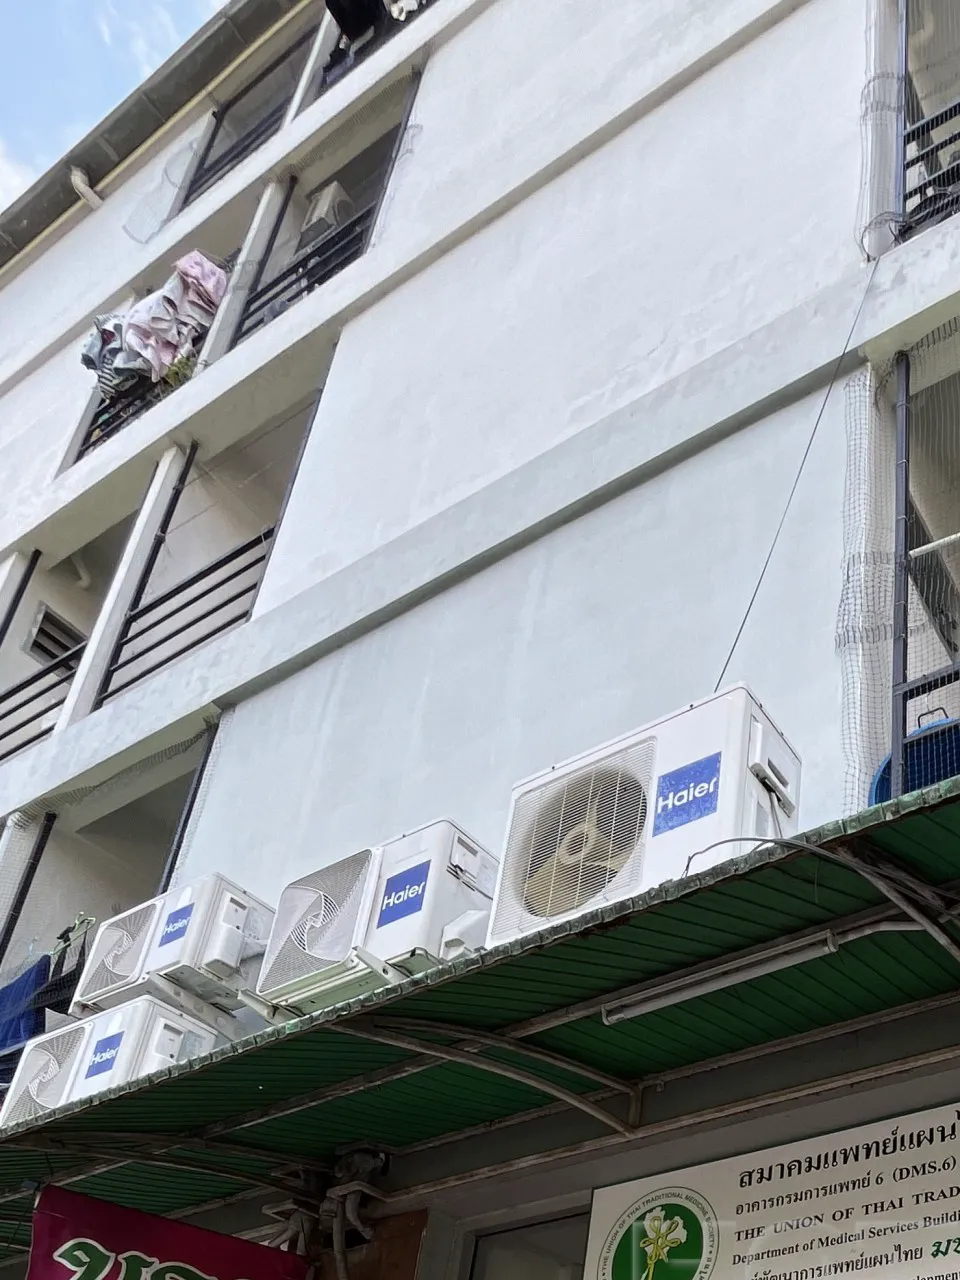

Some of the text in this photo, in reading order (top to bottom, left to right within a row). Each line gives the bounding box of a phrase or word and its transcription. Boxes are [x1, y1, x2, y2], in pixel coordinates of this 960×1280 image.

[657, 777, 717, 814] Haier
[382, 881, 425, 911] Haier
[163, 916, 191, 935] Haier
[89, 1047, 119, 1066] Haier
[735, 1169, 871, 1216] อาคารกรมการแพทย์
[875, 1172, 884, 1186] 6
[892, 1155, 957, 1183] (DMS.6)
[607, 1230, 620, 1255] UNION
[627, 1204, 642, 1219] THAI
[642, 1192, 684, 1207] TRADITIONAL
[685, 1194, 708, 1218] MEDICINE
[735, 1226, 766, 1242] THE
[773, 1213, 825, 1234] UNION
[832, 1207, 855, 1222] OF
[862, 1197, 904, 1216] THAI
[732, 1243, 800, 1266] Department
[802, 1238, 816, 1253] of
[817, 1230, 865, 1249] Medical
[868, 1220, 919, 1239] Services
